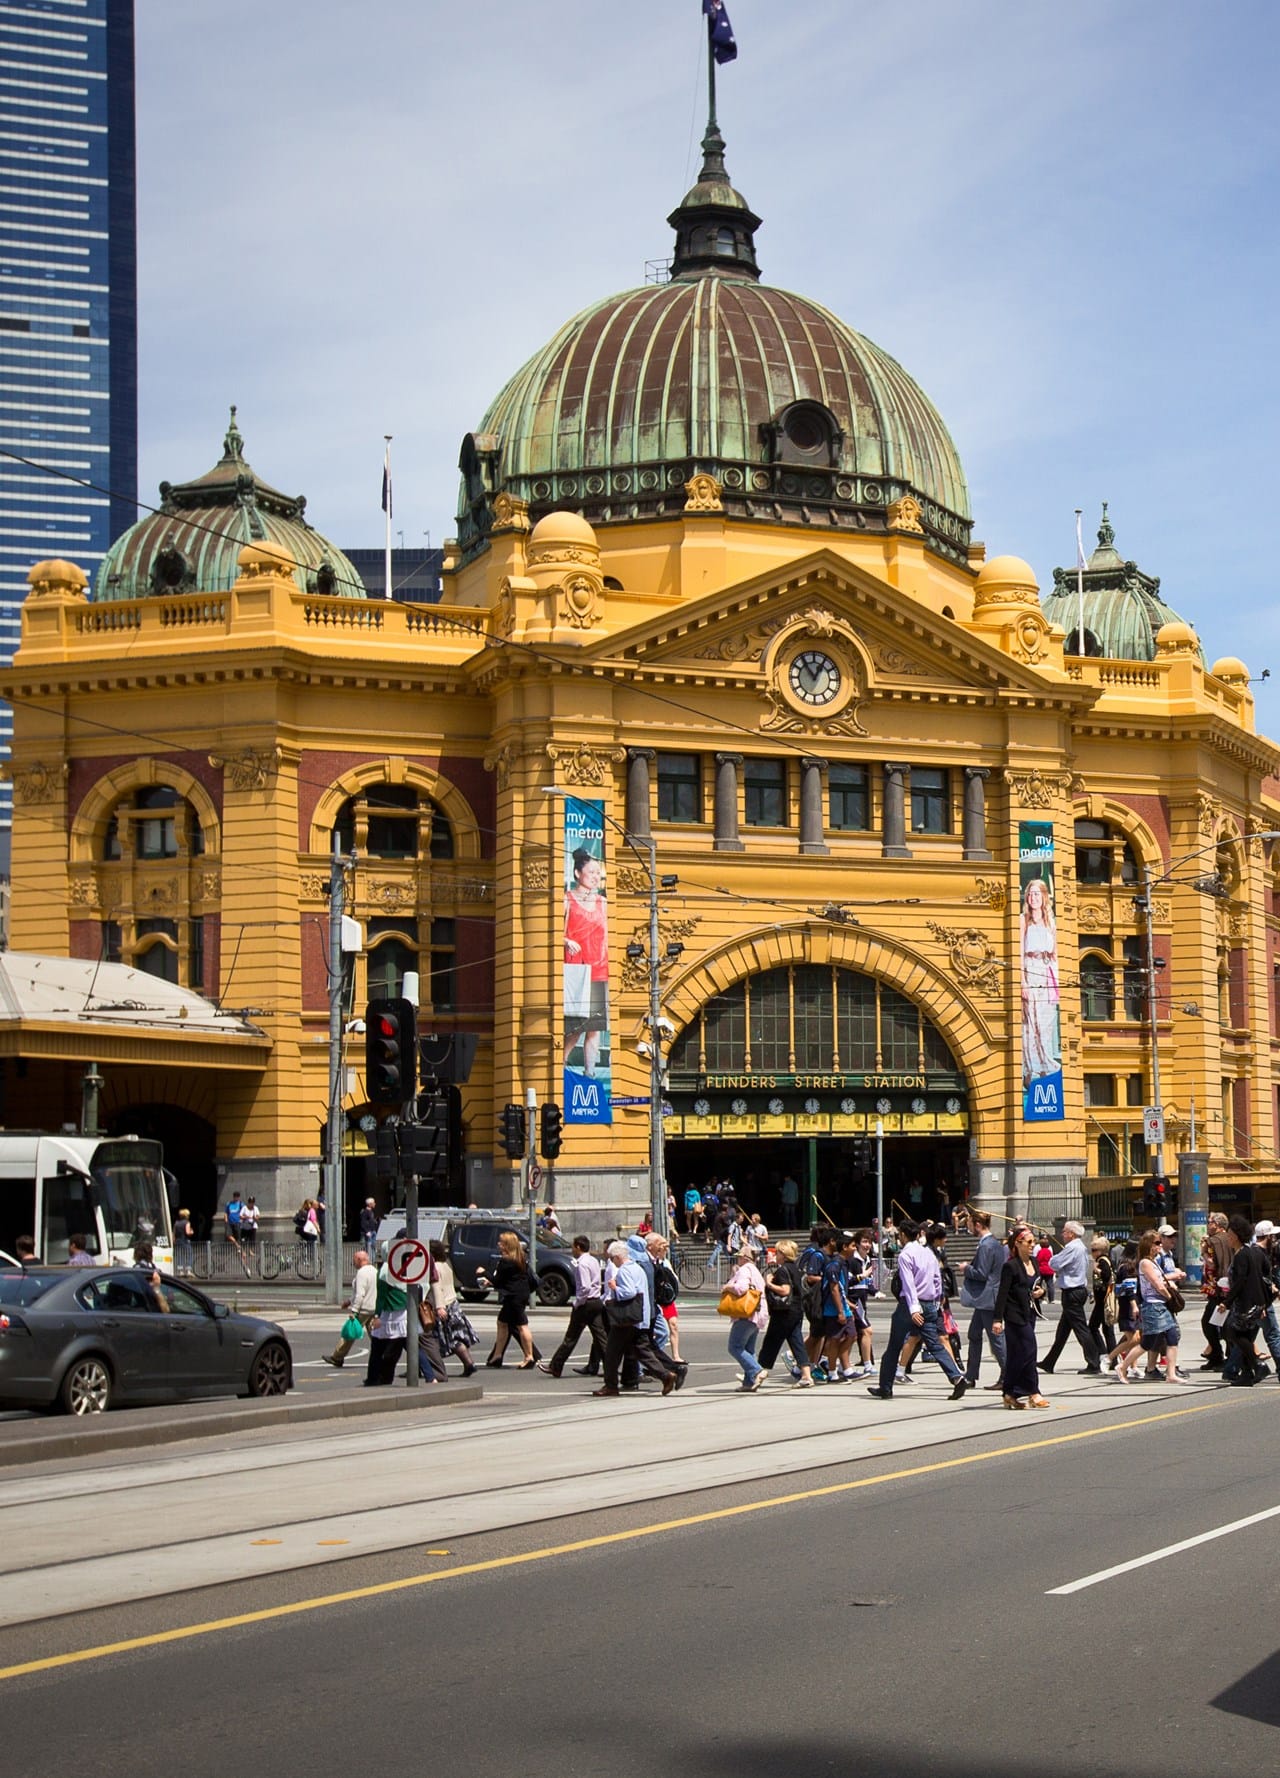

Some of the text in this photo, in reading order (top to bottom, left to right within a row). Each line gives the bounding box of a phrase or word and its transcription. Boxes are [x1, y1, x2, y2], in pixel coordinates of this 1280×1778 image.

[566, 812, 586, 826] my
[566, 826, 604, 840] metro
[1035, 835, 1052, 848] my
[1020, 847, 1053, 859] metro
[706, 1075, 927, 1089] FLINDERS STREET STATION
[572, 1108, 599, 1116] METRO
[1034, 1105, 1058, 1113] METRO
